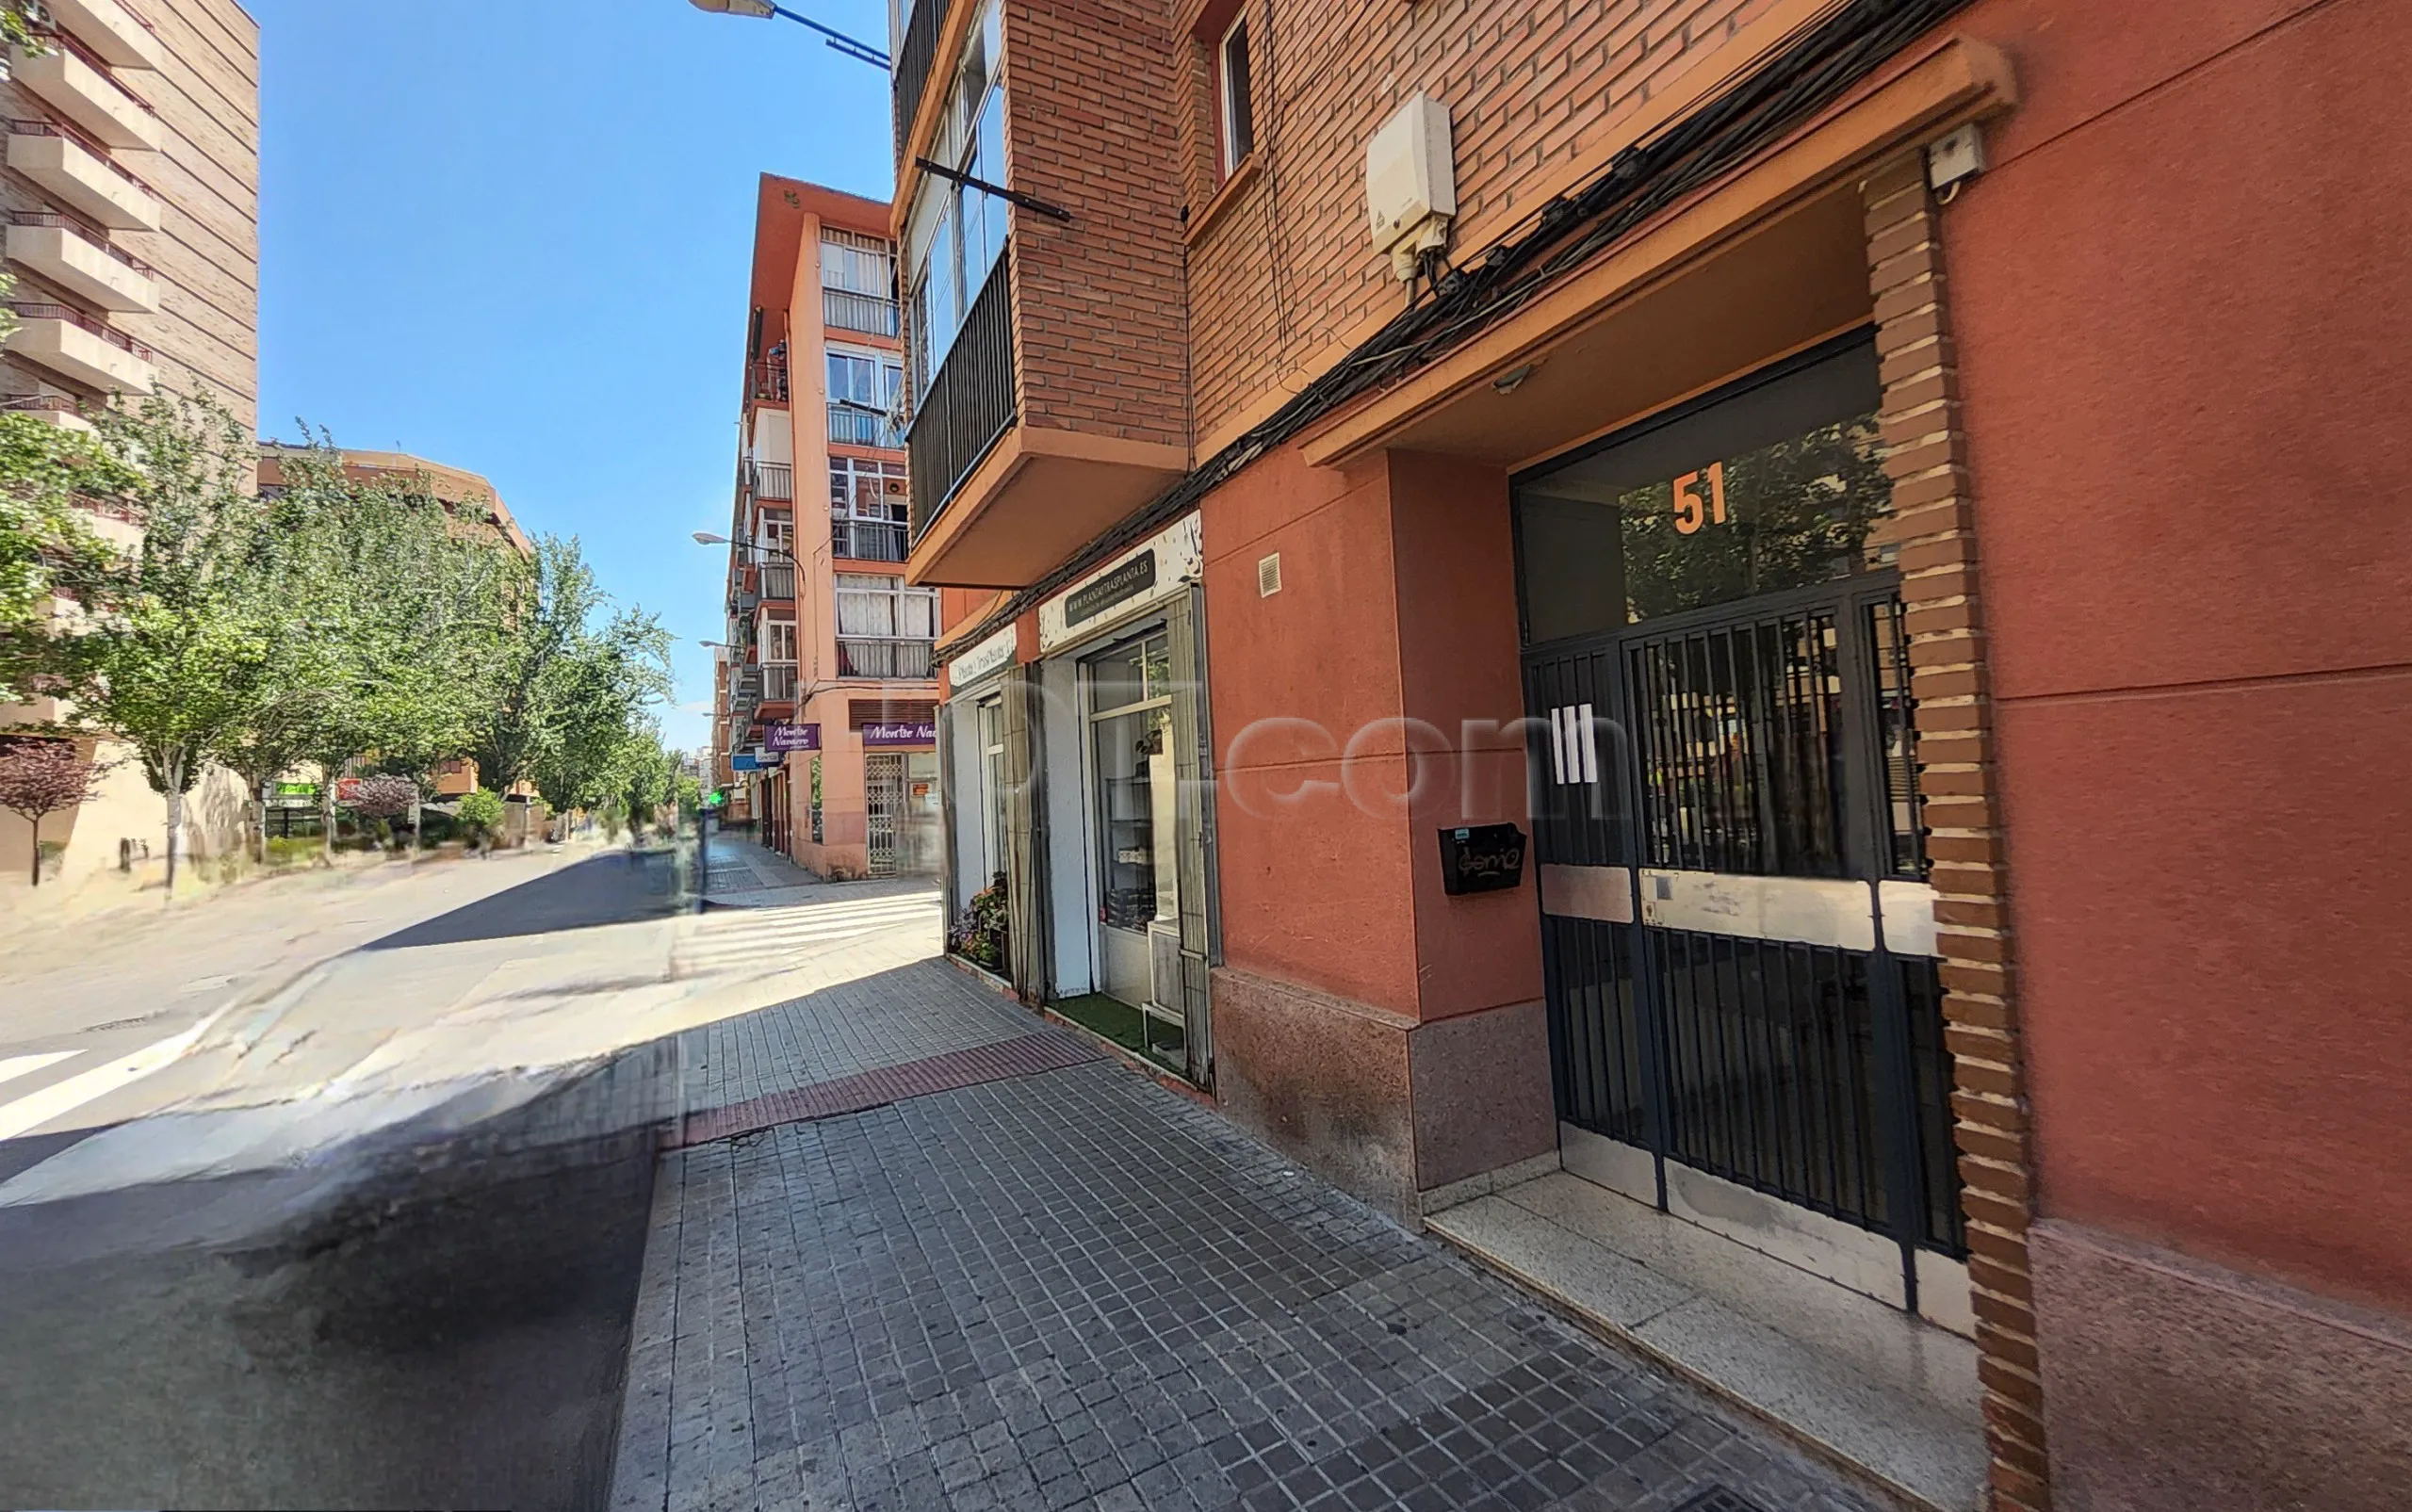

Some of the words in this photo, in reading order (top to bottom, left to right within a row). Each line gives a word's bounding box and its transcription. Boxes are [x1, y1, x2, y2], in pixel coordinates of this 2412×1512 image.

[1673, 461, 1726, 535] 51
[774, 724, 808, 737] Montse
[870, 724, 914, 740] Montse
[773, 737, 809, 747] Navarro
